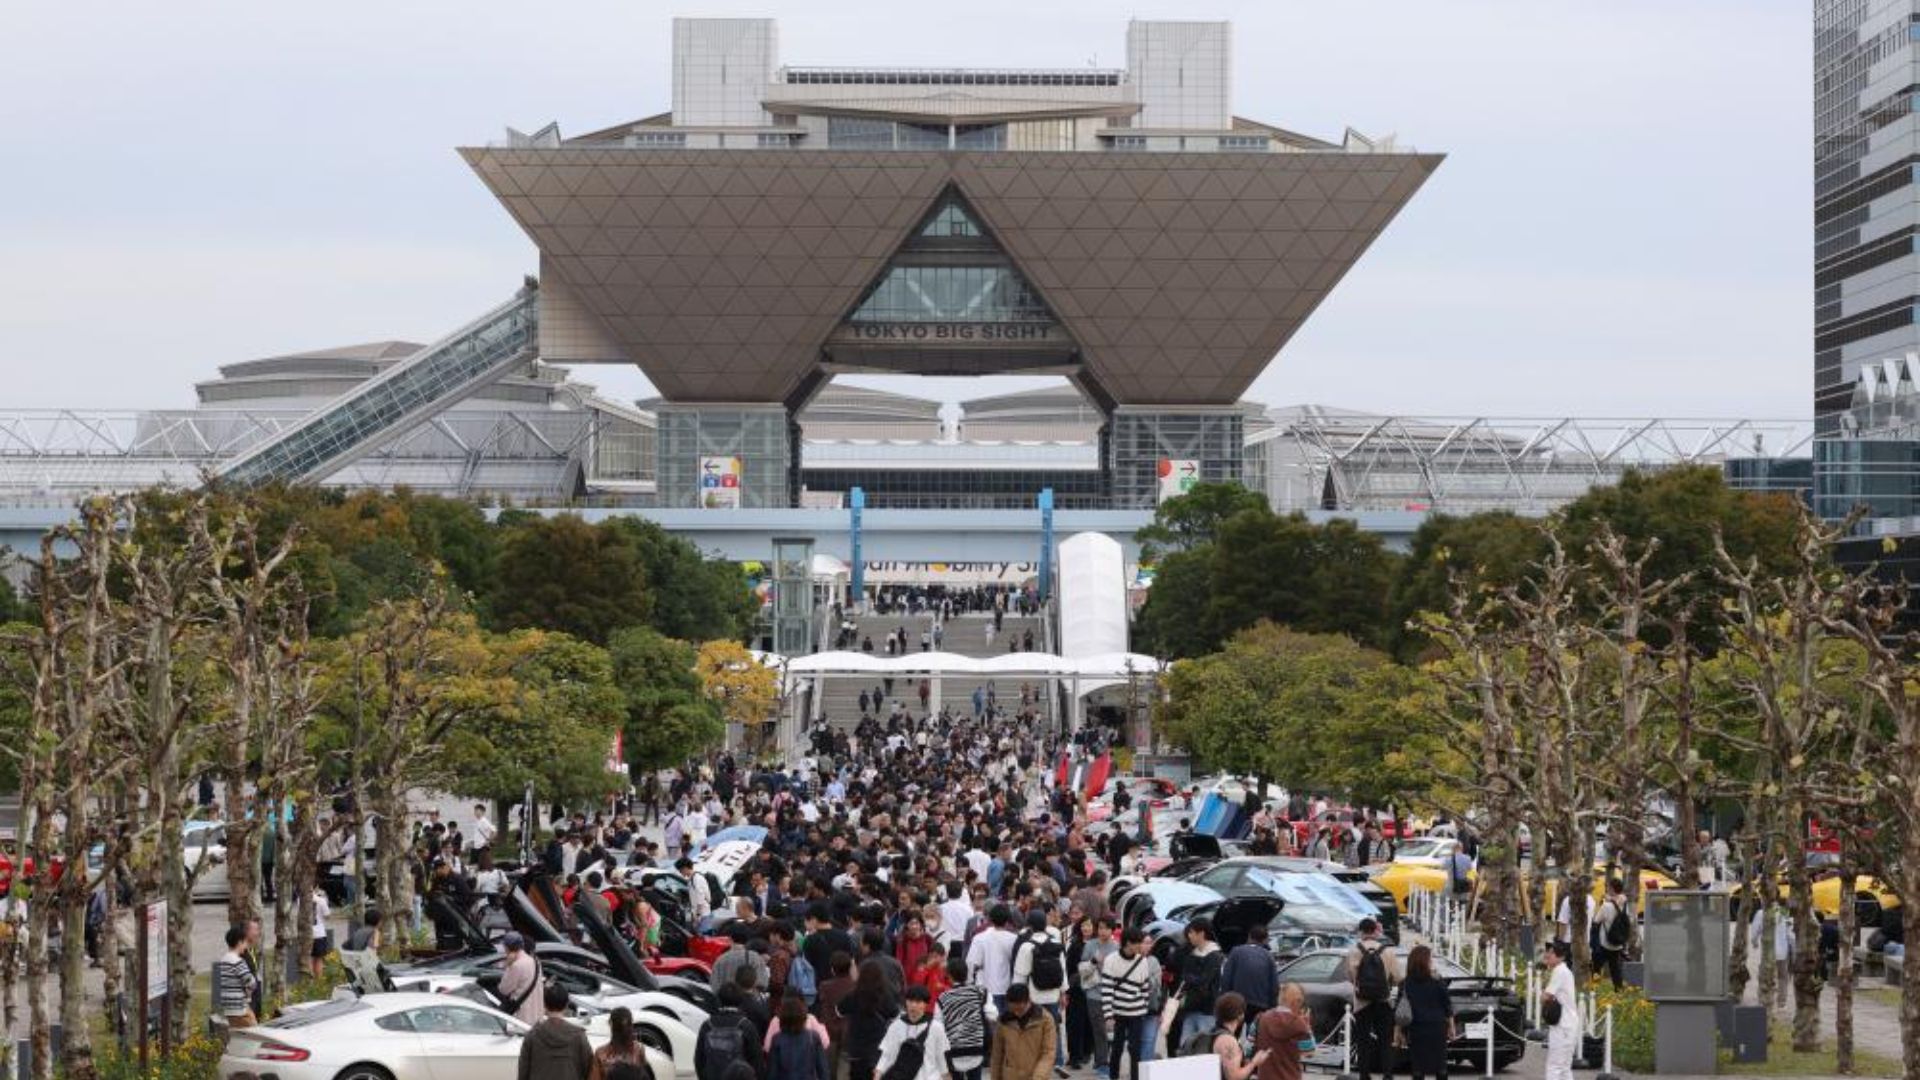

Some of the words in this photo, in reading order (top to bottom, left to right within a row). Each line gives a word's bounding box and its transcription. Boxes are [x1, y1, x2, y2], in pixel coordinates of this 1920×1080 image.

[852, 324, 927, 338] TOKYO
[936, 324, 973, 339] BIG
[982, 324, 1049, 339] SIGHT
